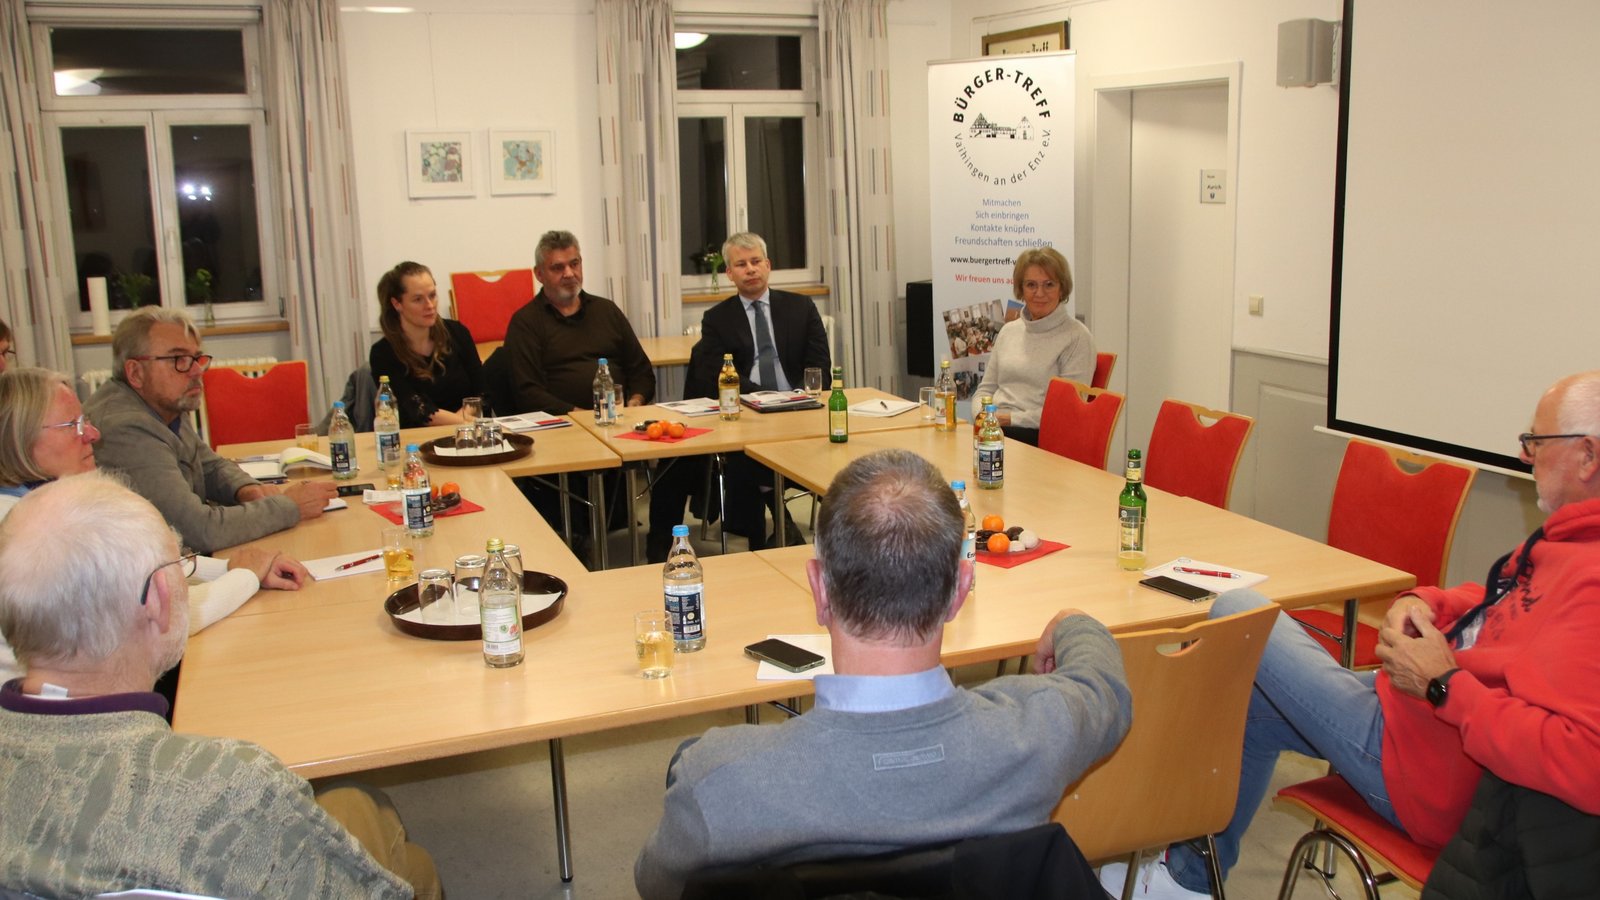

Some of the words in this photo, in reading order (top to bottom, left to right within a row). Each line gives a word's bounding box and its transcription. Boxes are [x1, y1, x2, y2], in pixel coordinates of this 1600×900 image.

[953, 68, 1051, 123] BÜRGER-TREFF
[954, 132, 990, 183] Vaihingen
[993, 177, 1006, 186] an
[1010, 170, 1027, 184] der
[1028, 150, 1046, 172] Enz
[982, 199, 1022, 207] Mitmachen
[975, 211, 990, 219] Sich
[991, 212, 1029, 221] einbringen
[970, 224, 1003, 232] Kontakte
[1004, 224, 1035, 234] knüpfen
[955, 236, 1013, 247] Freundschaften
[1014, 238, 1053, 248] schließen
[950, 256, 1016, 265] www.buergertreff-v
[955, 274, 967, 282] Wir
[968, 275, 991, 283] freuen
[992, 276, 1005, 284] uns
